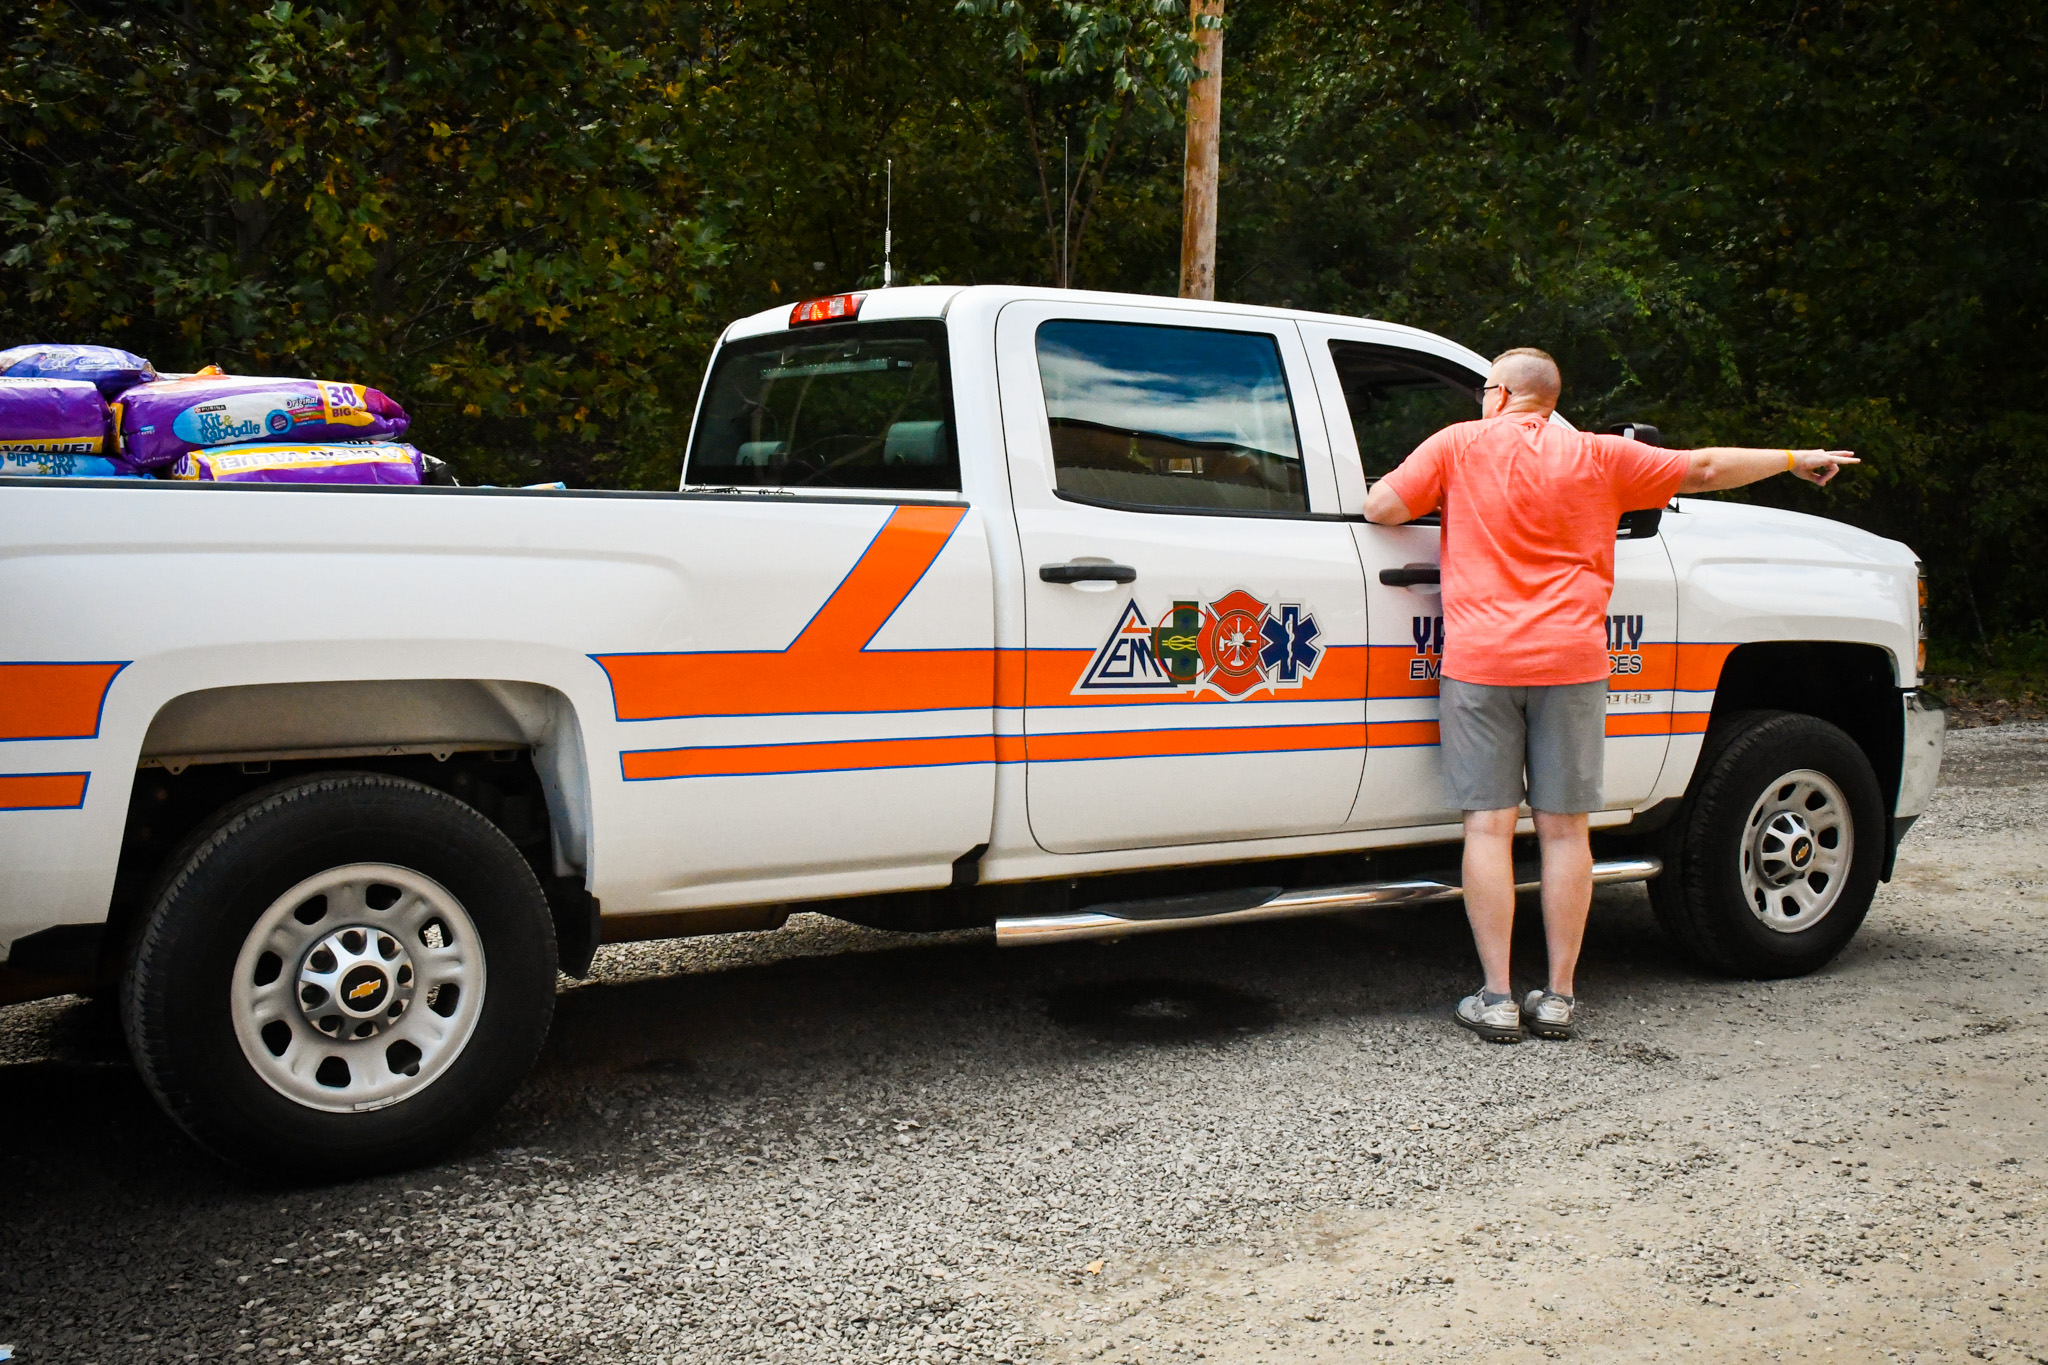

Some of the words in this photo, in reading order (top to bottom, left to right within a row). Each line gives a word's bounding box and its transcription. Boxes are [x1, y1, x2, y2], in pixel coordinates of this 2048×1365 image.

[286, 395, 318, 409] Original
[326, 386, 357, 406] 30
[332, 408, 352, 417] BIG
[198, 413, 223, 430] Kit
[223, 415, 233, 427] &
[198, 420, 260, 443] Kaboodle
